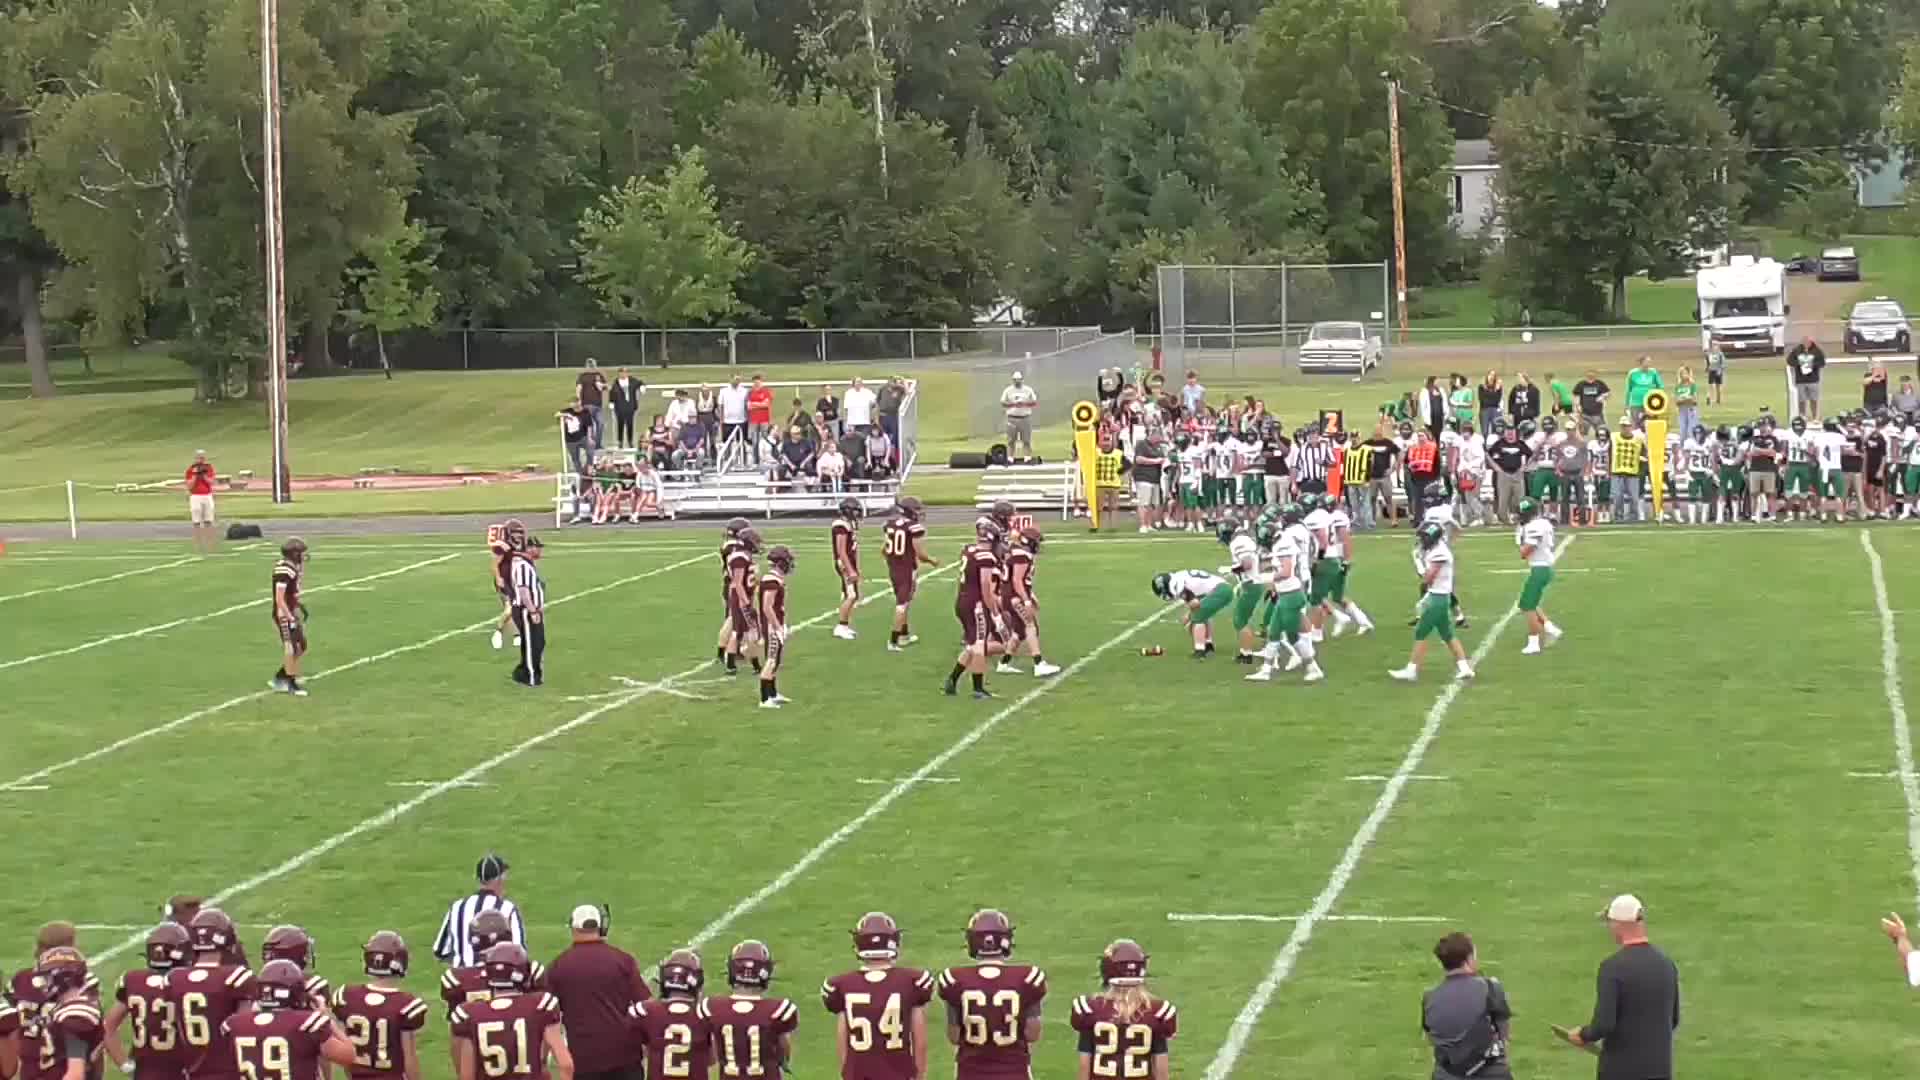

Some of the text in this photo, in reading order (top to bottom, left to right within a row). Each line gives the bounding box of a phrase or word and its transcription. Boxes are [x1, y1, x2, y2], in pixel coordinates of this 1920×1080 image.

[127, 995, 176, 1050] 33
[184, 992, 211, 1045] 6
[346, 1015, 392, 1069] 21
[845, 993, 903, 1051] 54
[961, 990, 1020, 1045] 63
[235, 1036, 290, 1080] 59
[477, 1018, 531, 1077] 51
[663, 1024, 692, 1077] 2
[722, 1024, 764, 1076] 11
[1093, 1021, 1153, 1077] 22
